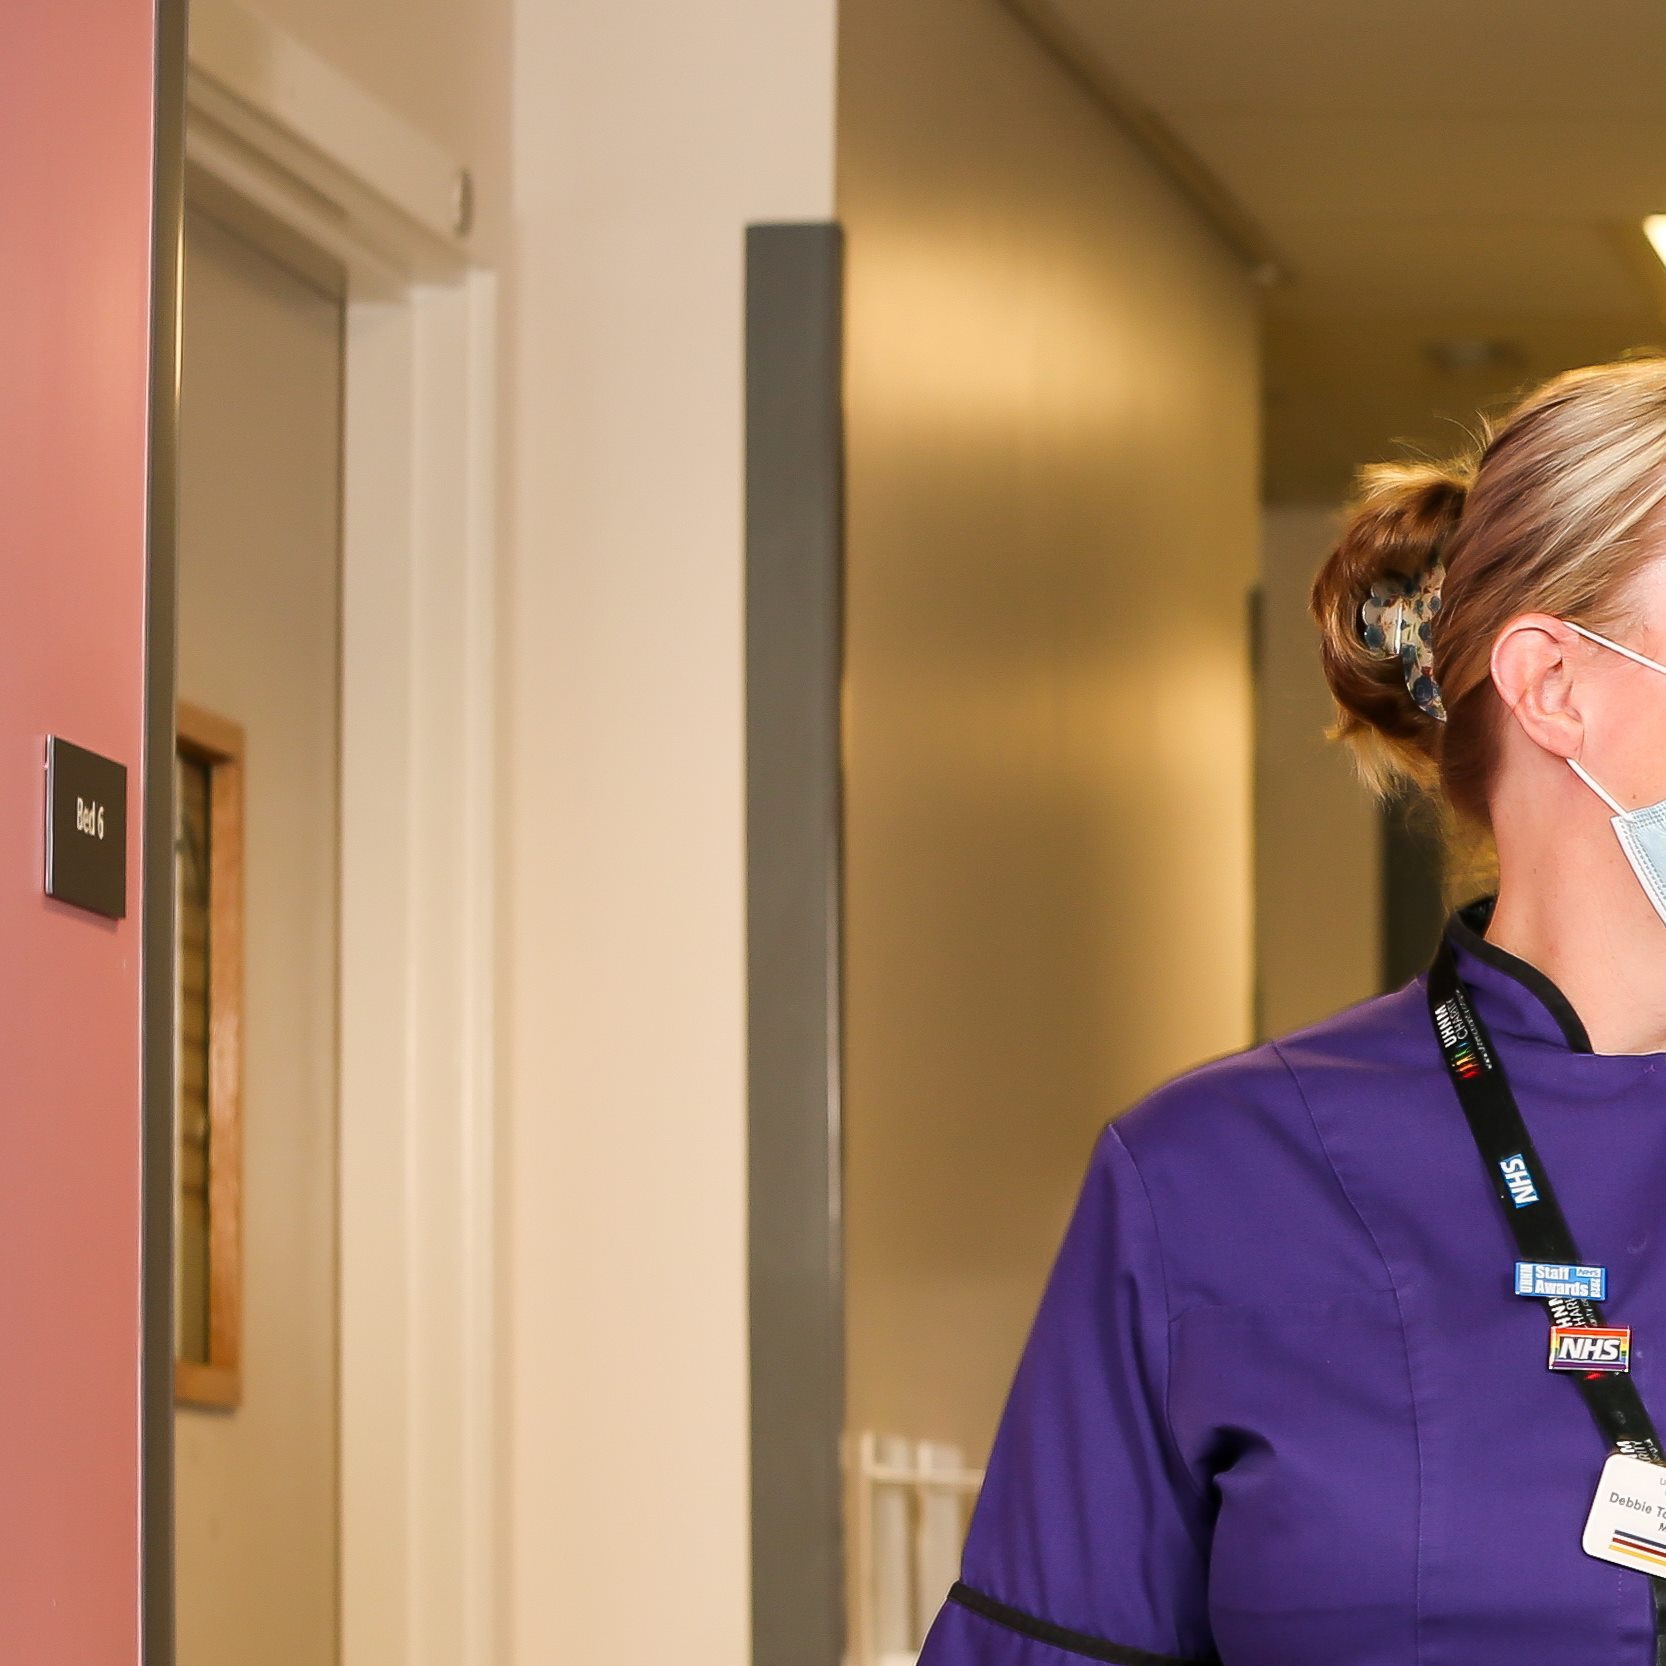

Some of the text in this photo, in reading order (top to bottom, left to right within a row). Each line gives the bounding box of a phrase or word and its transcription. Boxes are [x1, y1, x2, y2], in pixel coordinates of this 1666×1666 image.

[77, 797, 105, 841] Bed 6
[1435, 1004, 1458, 1048] UHNM
[1500, 1157, 1540, 1204] NHS
[1535, 1264, 1570, 1280] Staff
[1534, 1280, 1589, 1297] Awards
[1558, 1336, 1621, 1361] NHS
[1609, 1491, 1653, 1514] Debbie
